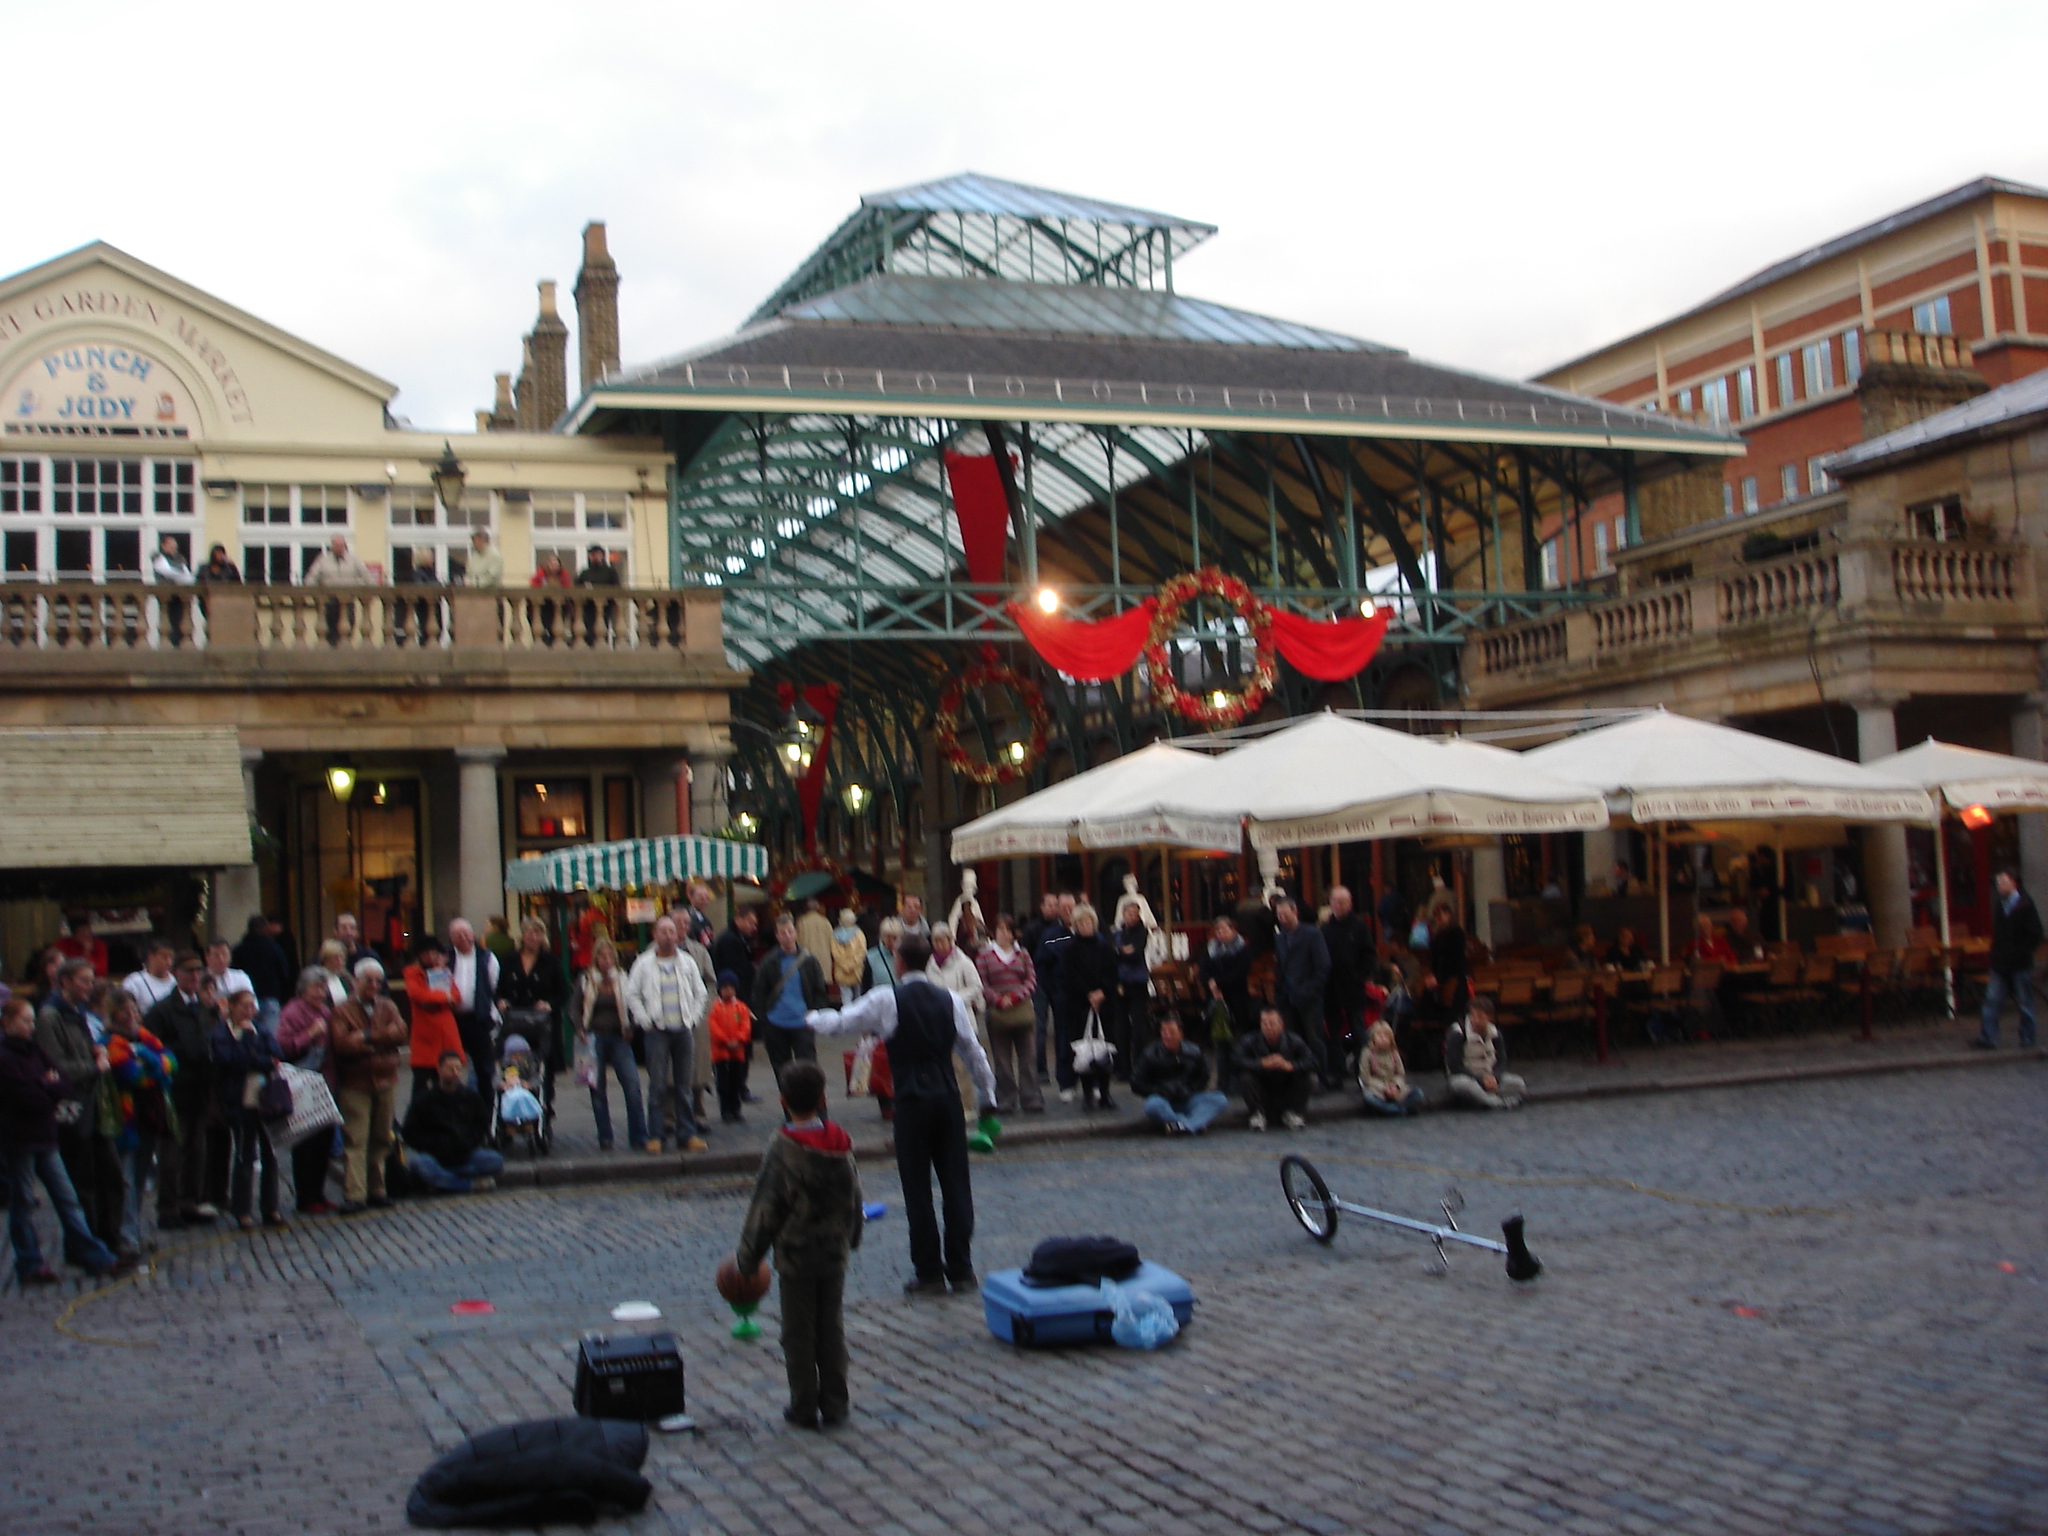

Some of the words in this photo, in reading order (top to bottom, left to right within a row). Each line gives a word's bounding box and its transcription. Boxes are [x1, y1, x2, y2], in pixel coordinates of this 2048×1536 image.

[33, 290, 165, 325] GARDEN
[43, 347, 153, 382] PUNCH
[86, 370, 107, 393] &
[57, 396, 136, 419] JUDY
